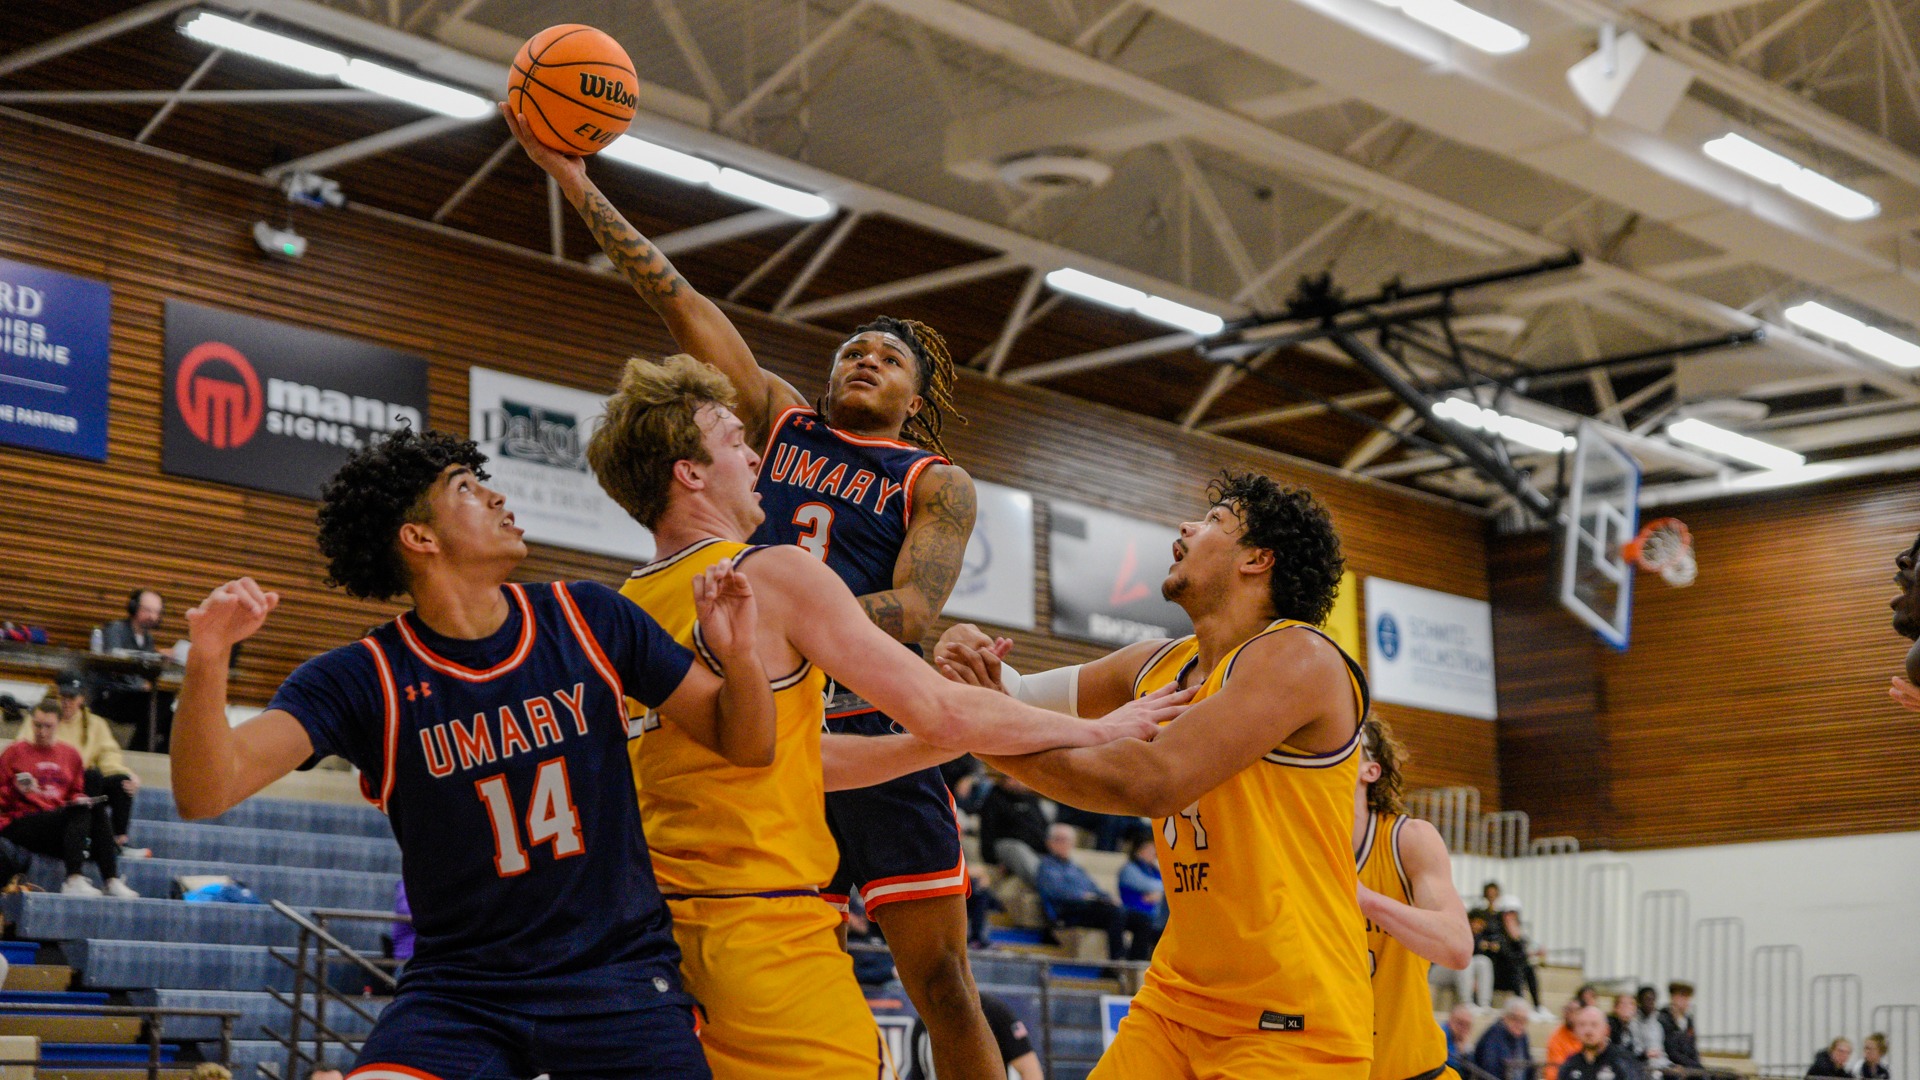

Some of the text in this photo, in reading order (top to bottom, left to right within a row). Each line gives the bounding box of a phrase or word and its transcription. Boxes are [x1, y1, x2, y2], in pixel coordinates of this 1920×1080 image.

[267, 378, 421, 438] mann
[771, 443, 901, 515] UMARY
[792, 501, 834, 563] 3
[419, 682, 588, 778] UMARY
[474, 755, 585, 878] 14
[1288, 1020, 1300, 1028] XL
